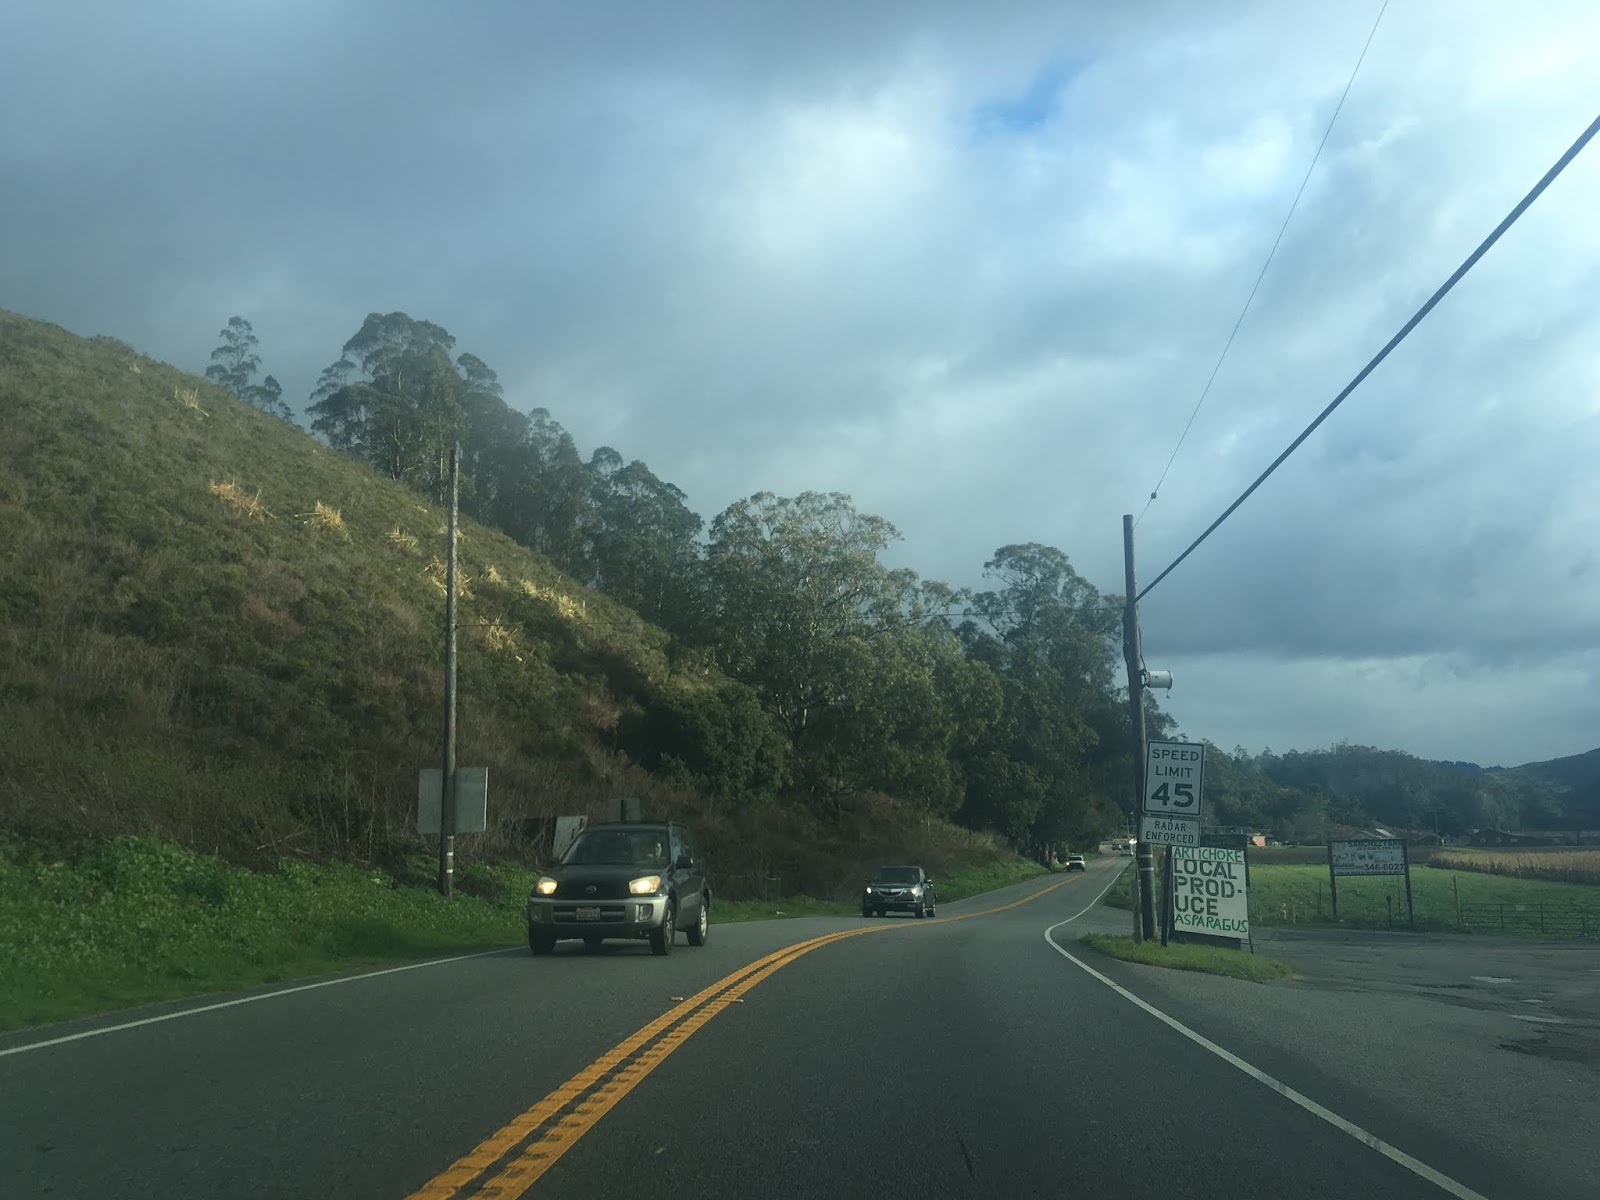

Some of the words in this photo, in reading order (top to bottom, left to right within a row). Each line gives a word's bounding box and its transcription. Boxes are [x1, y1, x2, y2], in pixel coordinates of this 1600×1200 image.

[1152, 749, 1199, 761] SPEED
[1155, 765, 1193, 778] LIMIT
[1151, 782, 1194, 808] 45
[1154, 820, 1187, 832] RADAR
[1145, 831, 1194, 844] ENFORCED
[1174, 847, 1243, 863] ARTICHOKE
[1174, 859, 1237, 880] LOCAL
[1174, 875, 1243, 898] PROD-
[1174, 895, 1219, 916] UCE
[1174, 913, 1248, 933] ASPARAGUS
